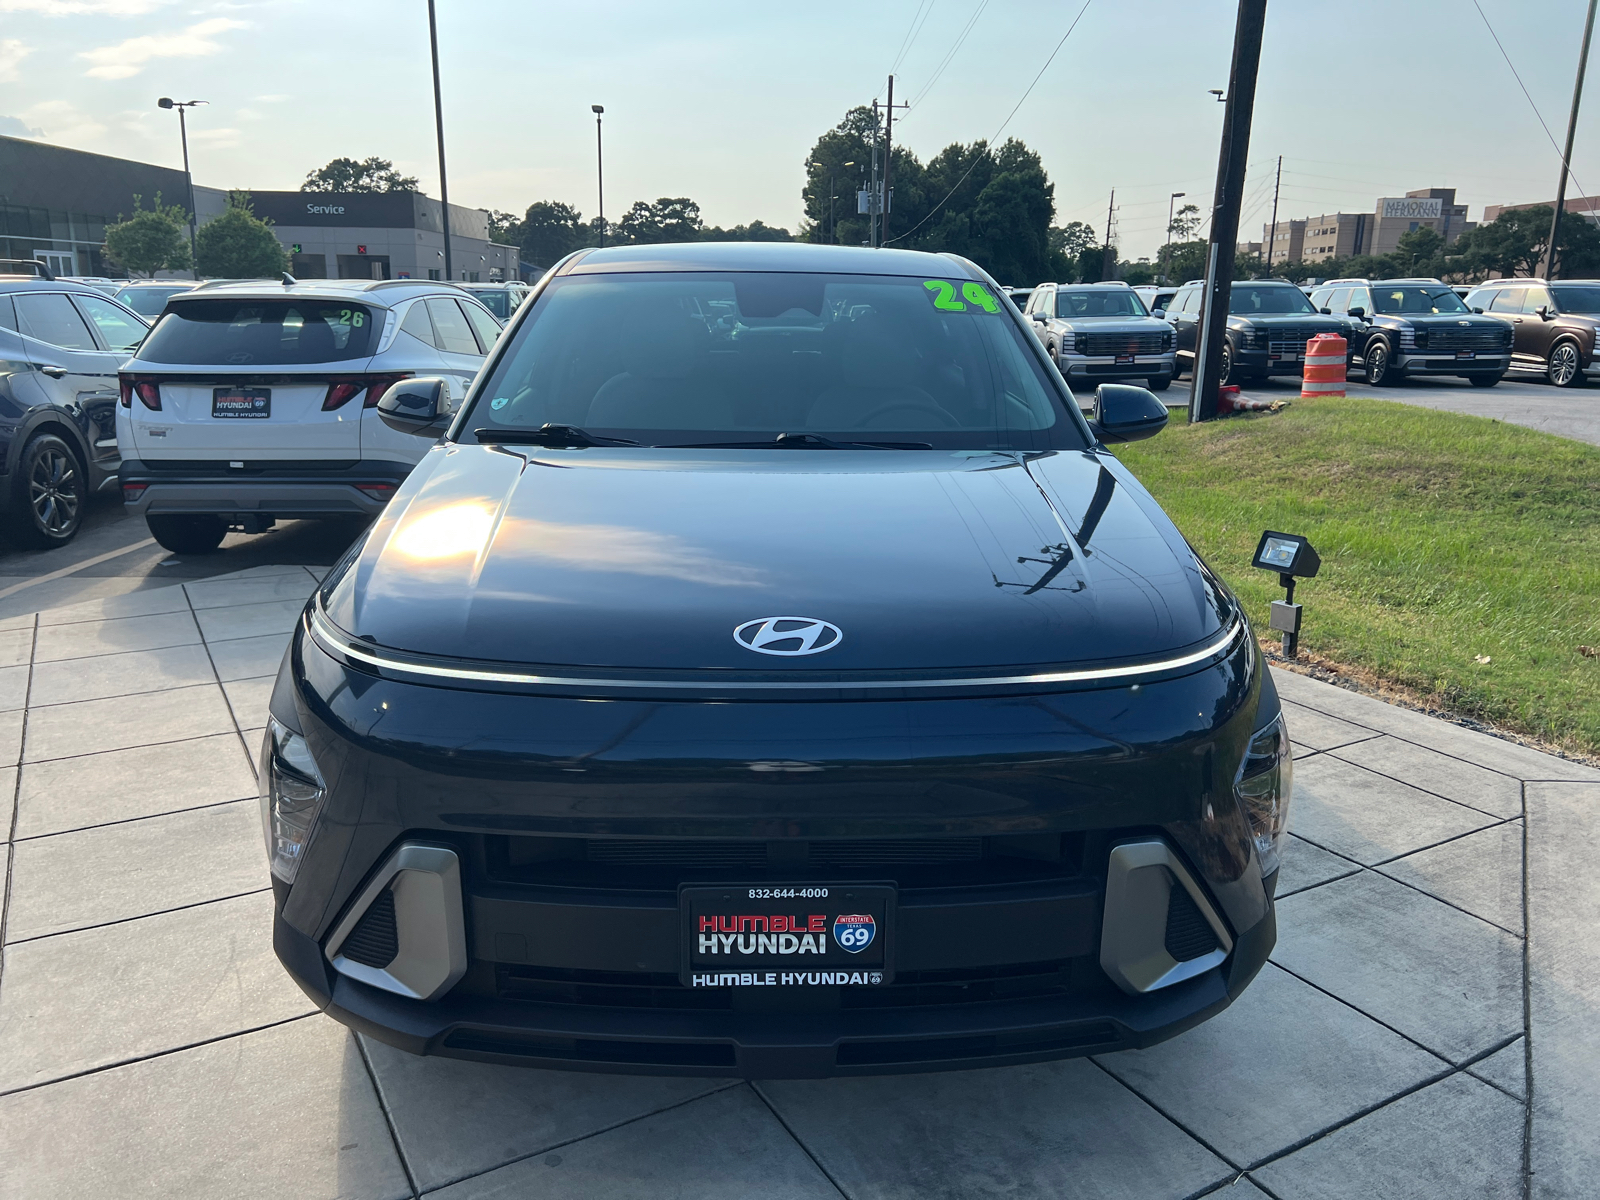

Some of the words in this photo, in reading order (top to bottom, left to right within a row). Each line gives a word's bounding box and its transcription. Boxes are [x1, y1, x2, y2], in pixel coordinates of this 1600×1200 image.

[306, 203, 345, 214] Service
[1385, 209, 1439, 217] HERMANN
[1386, 201, 1440, 210] MEMORIAL
[923, 280, 1002, 314] 24
[339, 309, 364, 327] 26
[748, 888, 829, 899] 832-644-4000
[698, 915, 827, 932] HUMBLE
[698, 933, 827, 955] HYUNDAI
[840, 928, 869, 946] 69
[692, 973, 777, 987] HUMBLE
[781, 972, 868, 985] HYUNDAI
